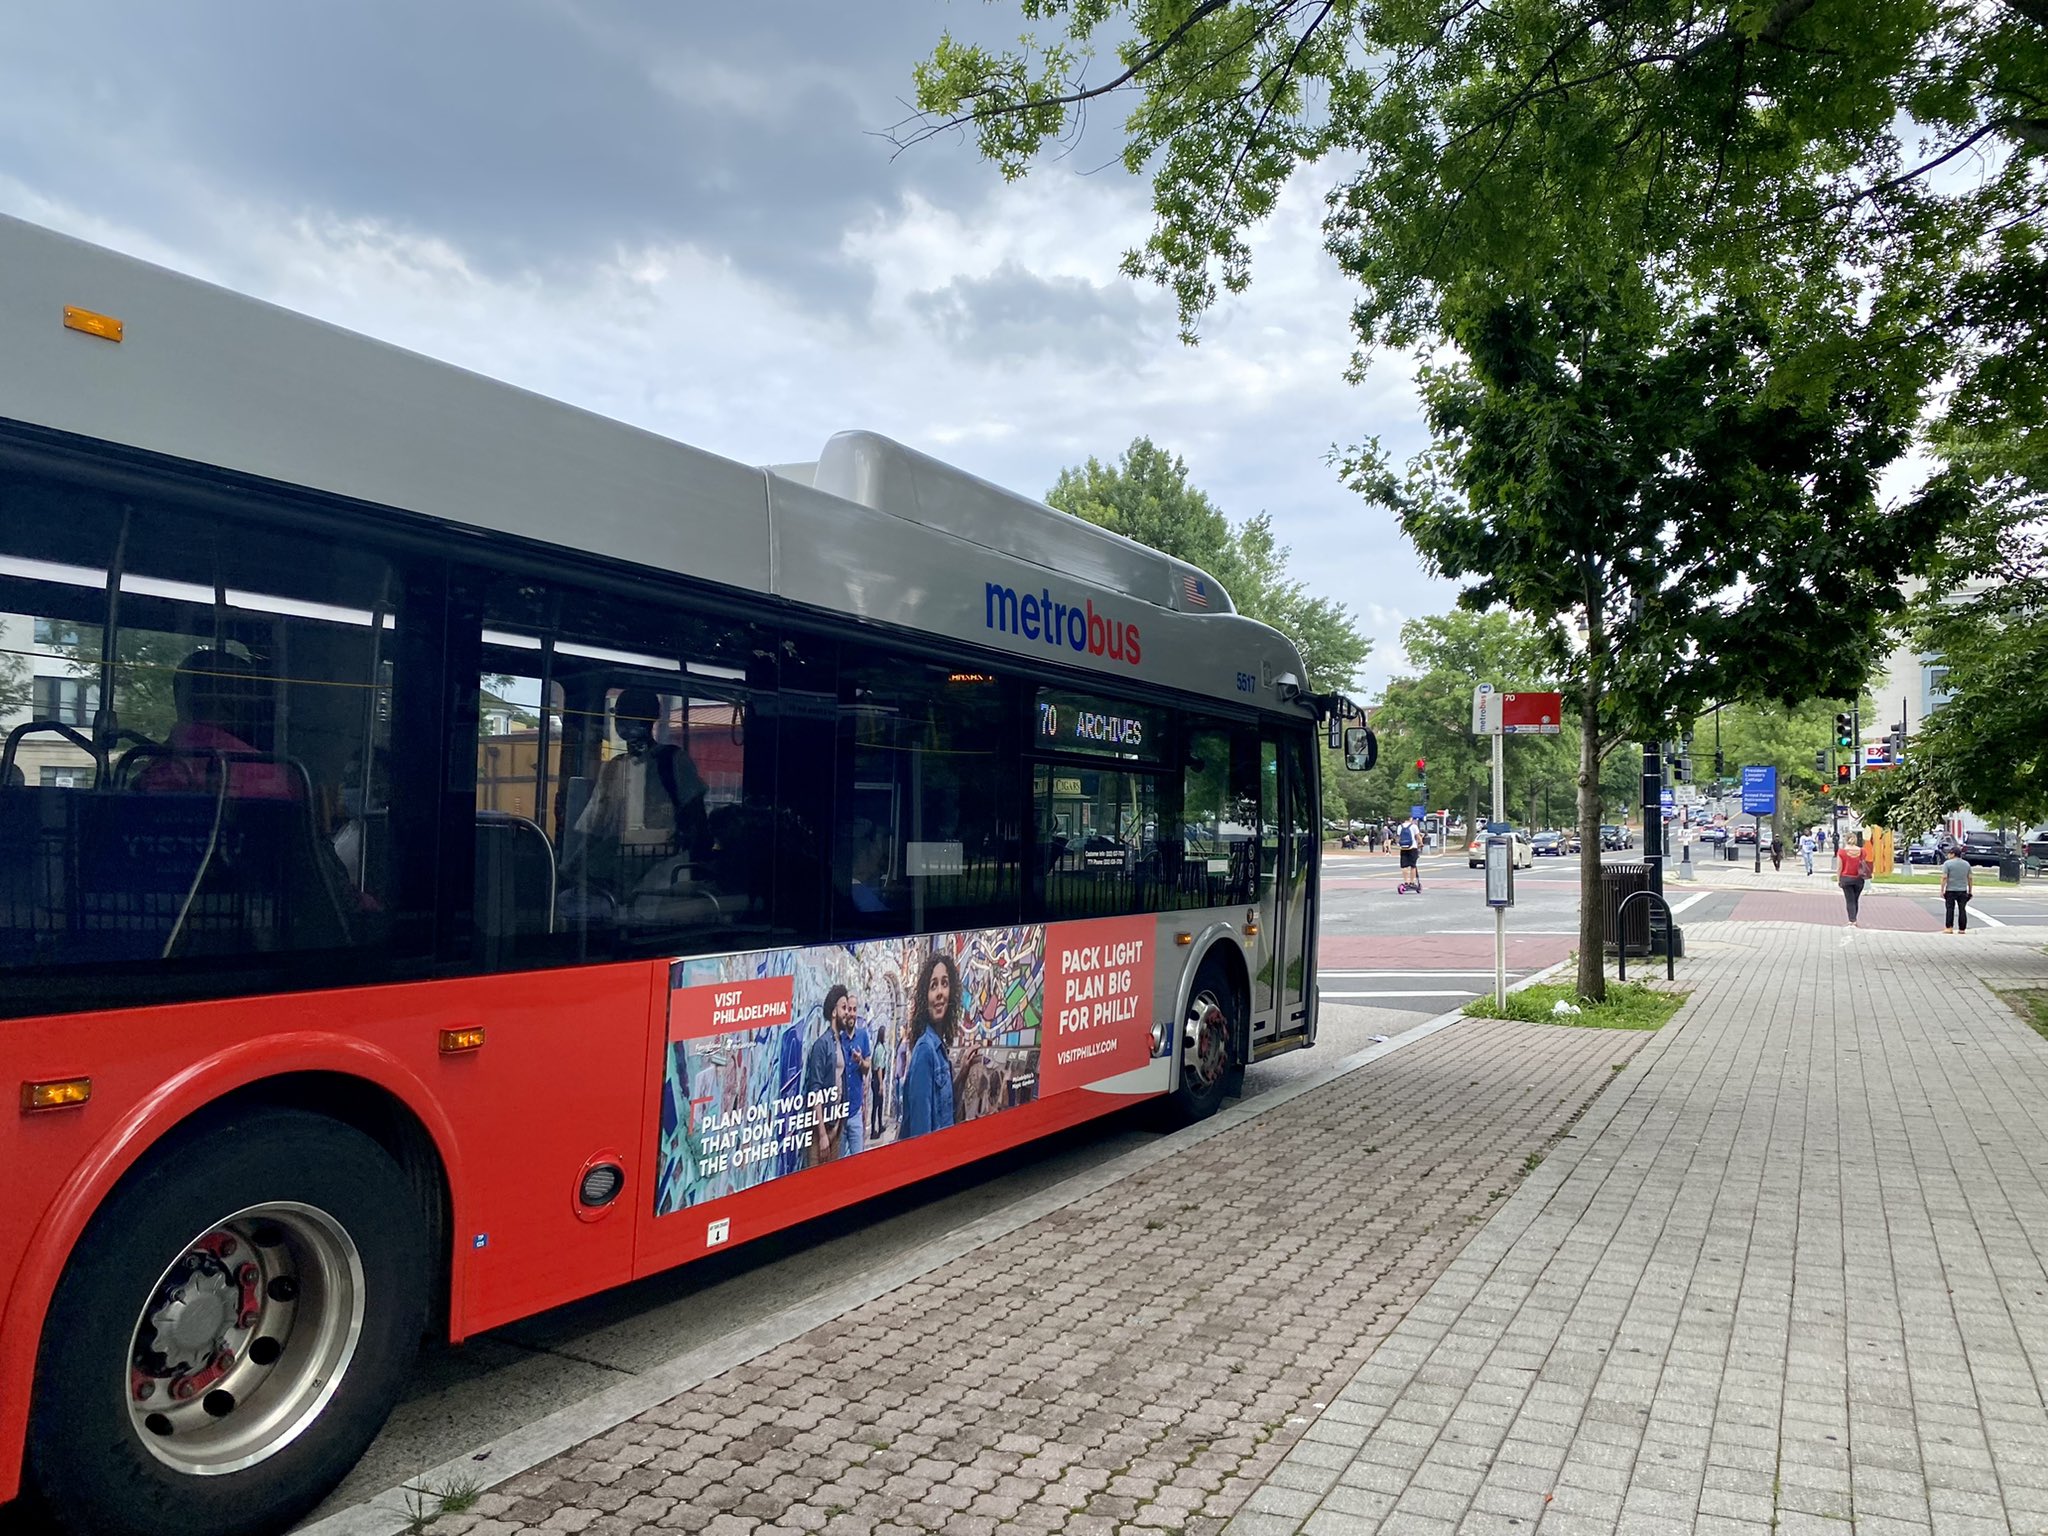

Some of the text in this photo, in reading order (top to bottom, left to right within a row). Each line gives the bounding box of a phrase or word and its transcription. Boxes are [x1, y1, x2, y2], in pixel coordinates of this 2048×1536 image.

[985, 582, 1141, 665] metrobus
[1236, 671, 1256, 693] 5517
[1504, 694, 1516, 702] 70
[1040, 703, 1142, 745] 70 ARCHIVES
[1061, 940, 1143, 975] PACK LIGHT
[714, 991, 743, 1008] VISIT
[1065, 969, 1132, 1004] PLAN BIG
[713, 1001, 787, 1025] PHILADELPHIA
[1059, 995, 1139, 1035] FOR PHILLY
[1057, 1038, 1118, 1065] VISITPHILLY.COM
[701, 1086, 839, 1134] PLAN ON TWO DAYS
[700, 1102, 850, 1155] THAT DON'T FEEL LIKE
[699, 1131, 813, 1177] THE OTHER FIVE
